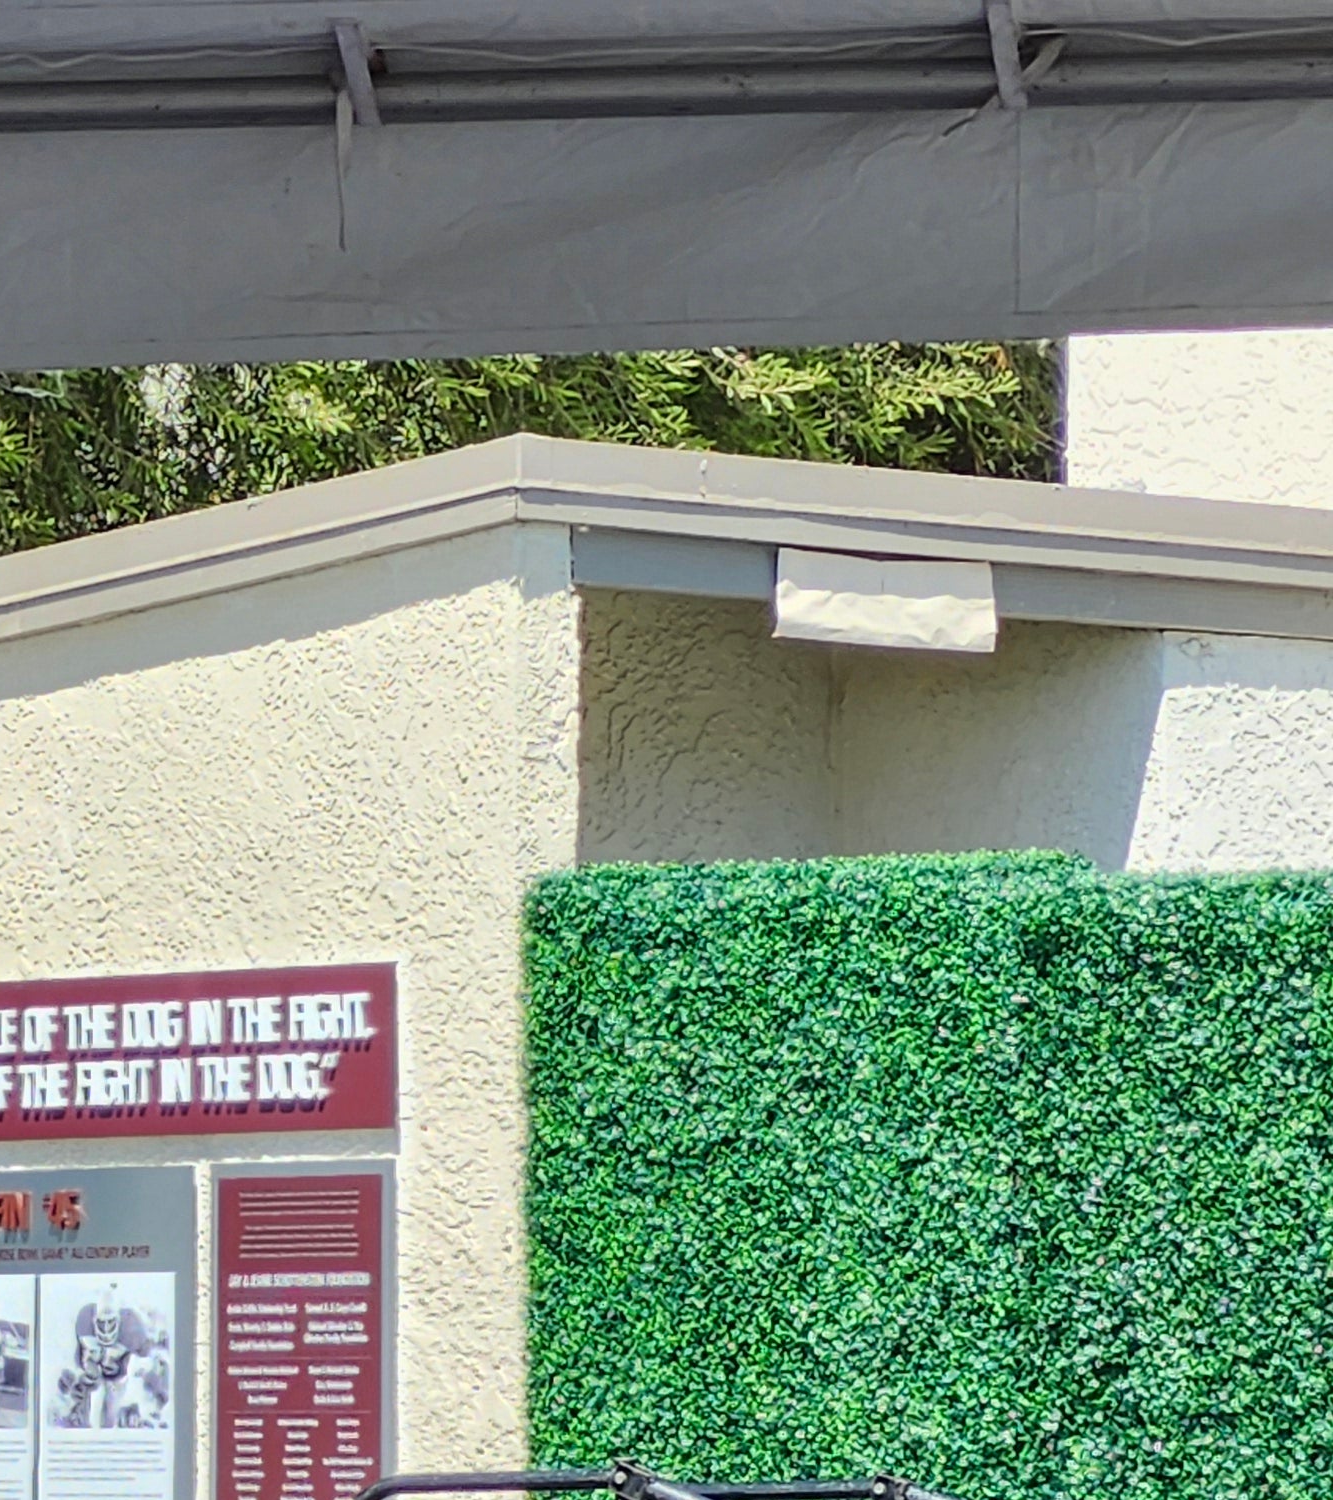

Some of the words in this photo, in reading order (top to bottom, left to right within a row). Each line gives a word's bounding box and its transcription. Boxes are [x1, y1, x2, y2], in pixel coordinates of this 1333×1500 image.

[22, 1007, 59, 1053] OF
[62, 1004, 115, 1050] THE
[121, 1002, 183, 1048] DOG
[188, 999, 223, 1045] IN
[226, 997, 282, 1042] THE
[17, 1063, 69, 1109] THE
[75, 1059, 154, 1107] FIGHT
[158, 1057, 193, 1104] IN
[196, 1055, 252, 1102] THE
